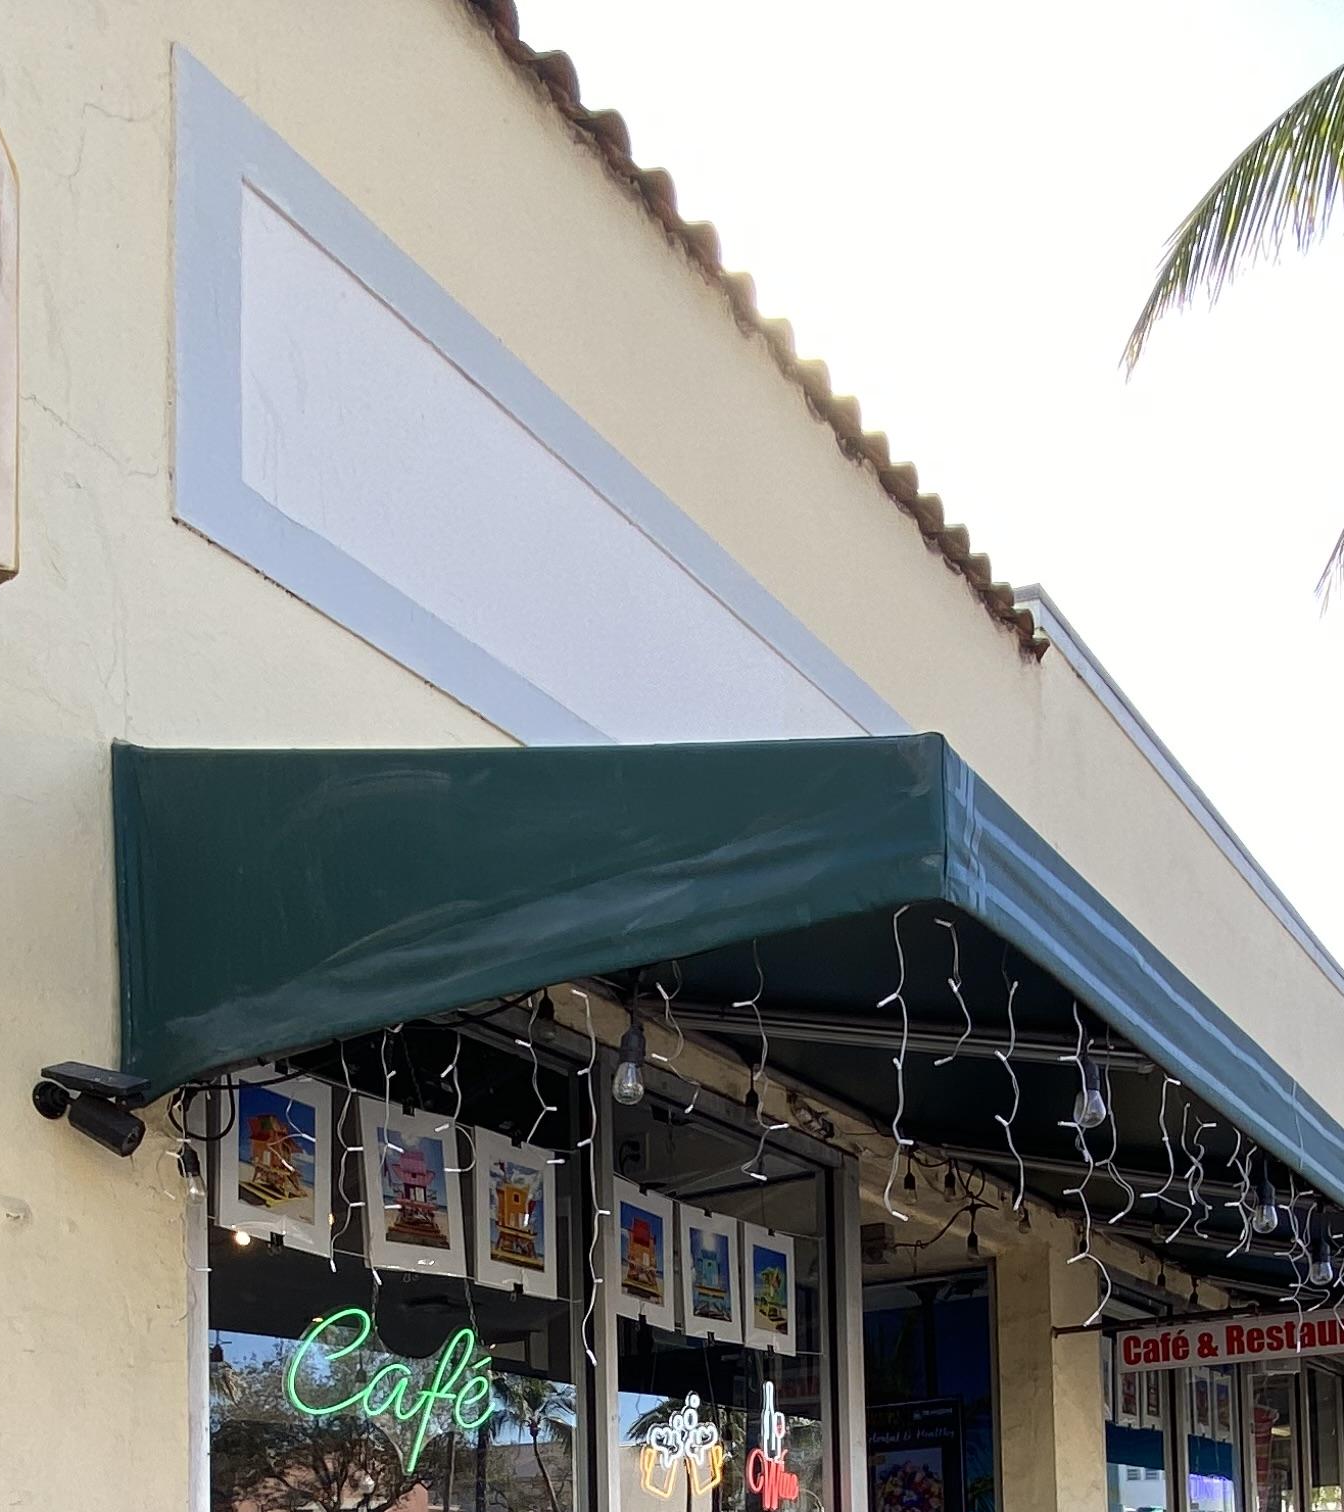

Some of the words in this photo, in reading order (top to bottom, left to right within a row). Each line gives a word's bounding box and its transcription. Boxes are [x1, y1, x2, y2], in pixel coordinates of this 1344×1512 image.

[288, 1308, 496, 1473] Café
[1123, 1329, 1189, 1365] Café
[1197, 1332, 1218, 1358] &
